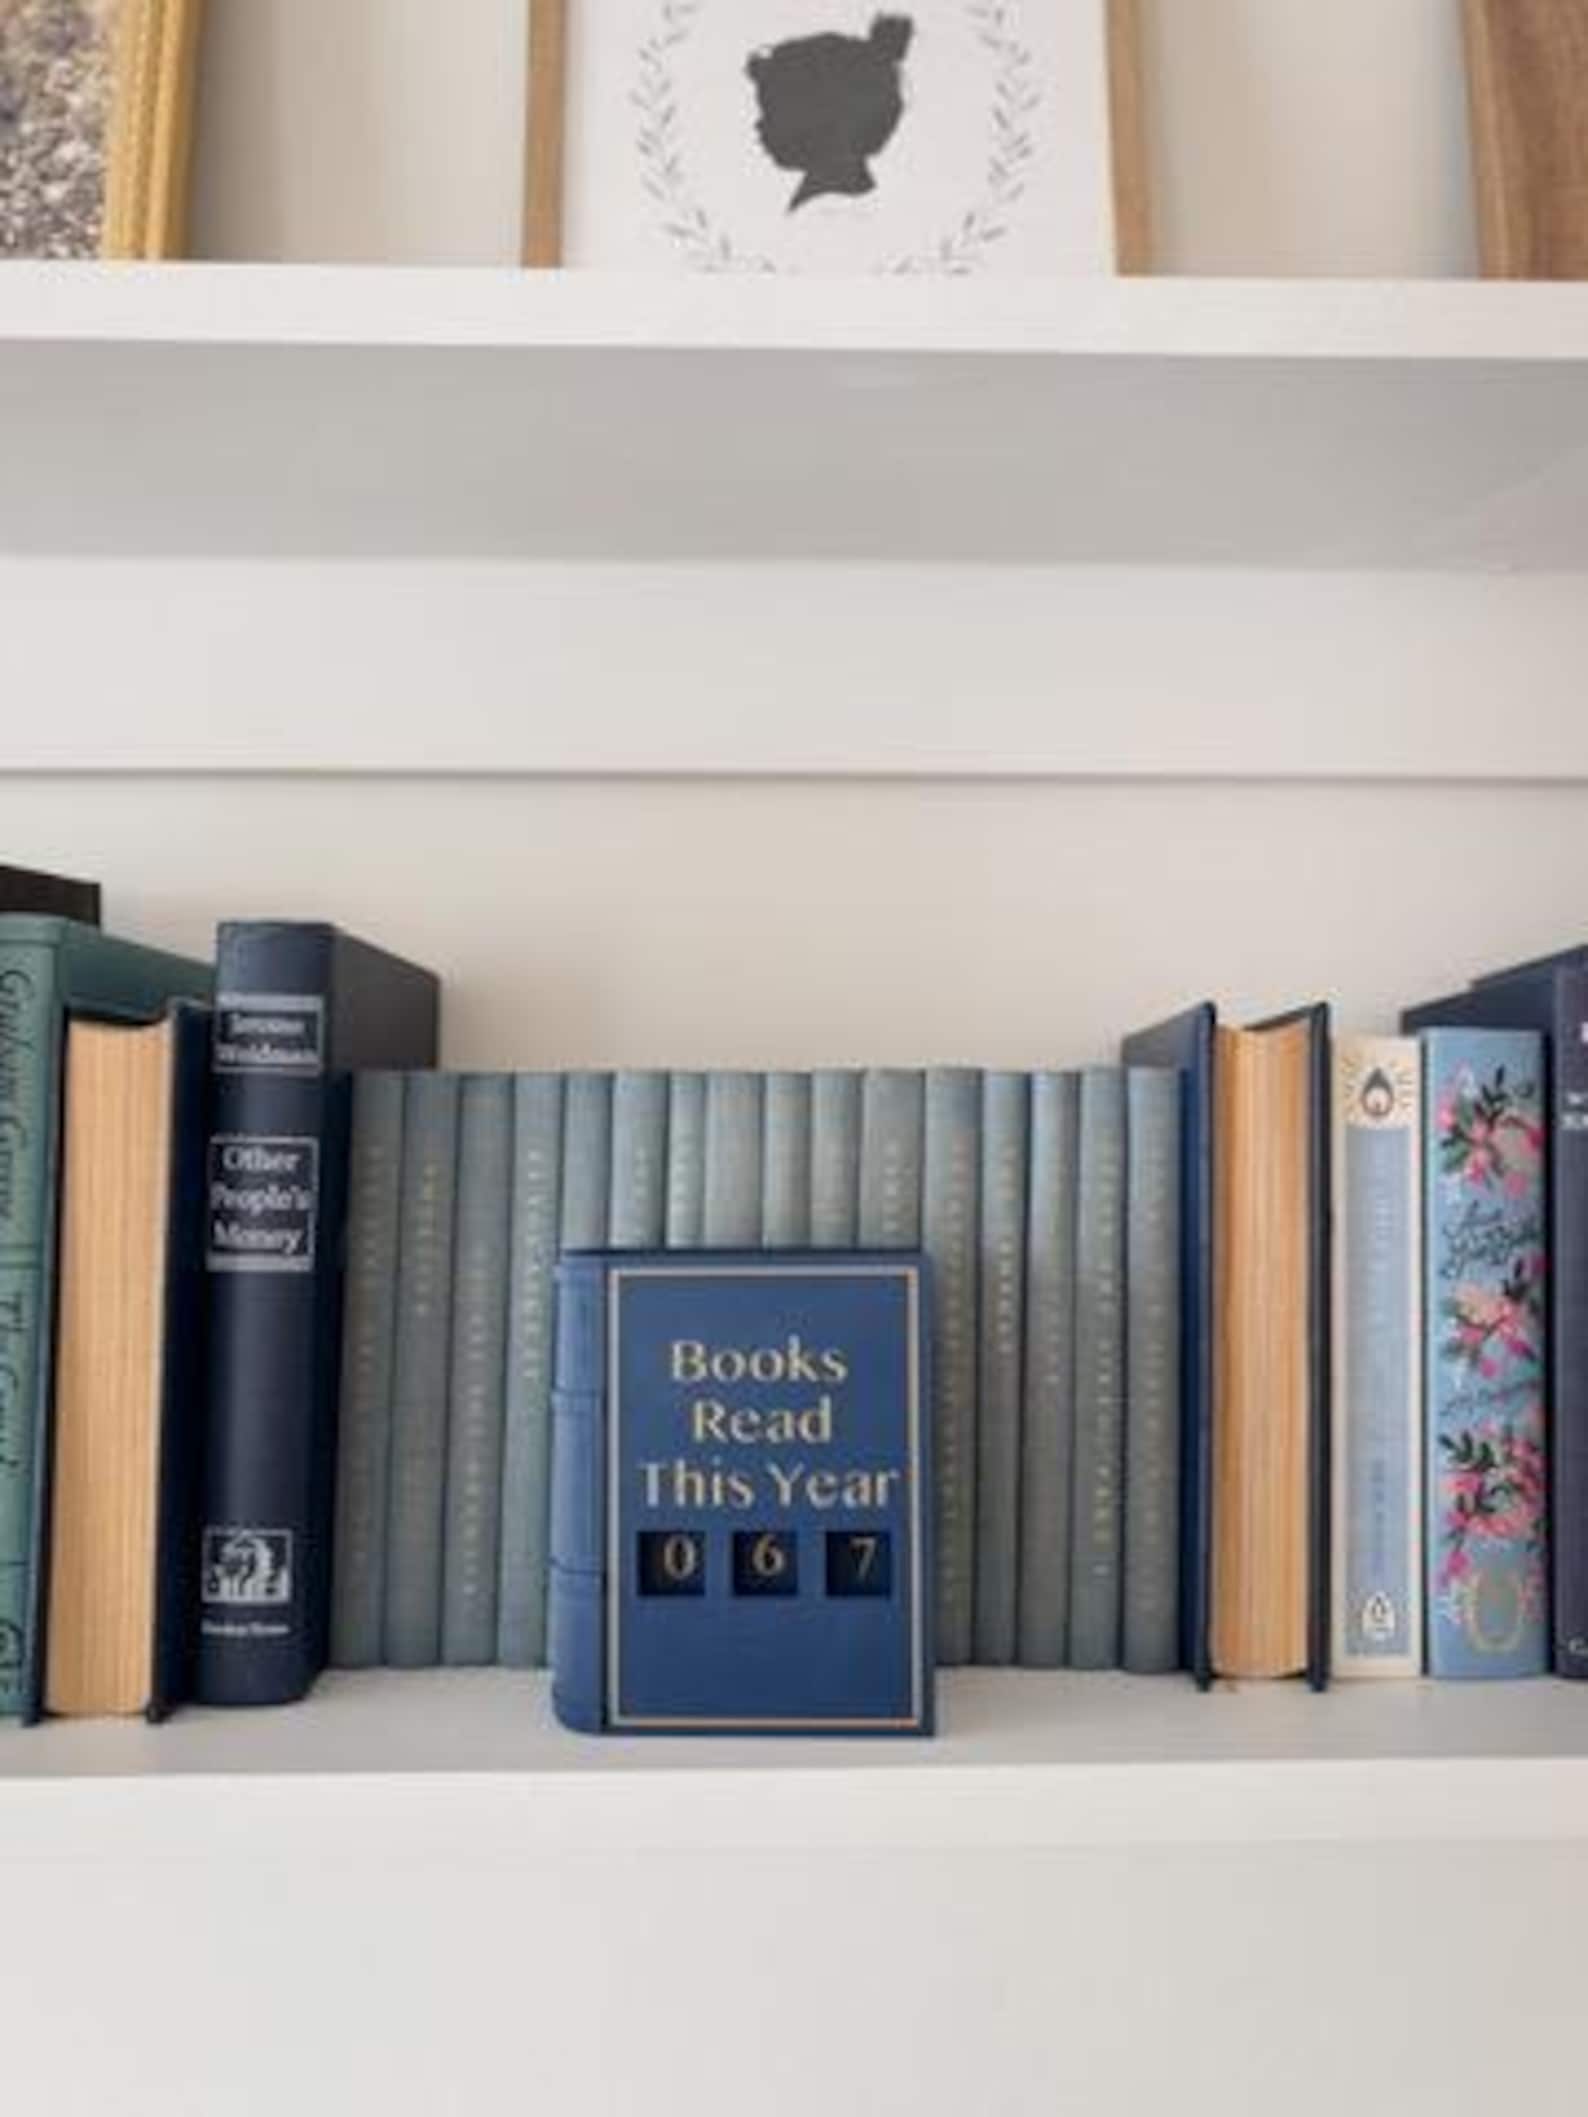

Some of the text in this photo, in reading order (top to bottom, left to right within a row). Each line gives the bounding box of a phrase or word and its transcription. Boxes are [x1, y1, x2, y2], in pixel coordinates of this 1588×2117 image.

[223, 1145, 300, 1171] Other
[210, 1181, 311, 1216] People's
[213, 1219, 303, 1255] Money
[671, 1334, 848, 1383] Books
[692, 1396, 832, 1443] Read
[639, 1456, 899, 1508] This Year
[662, 1533, 877, 1580] 0 6 7
